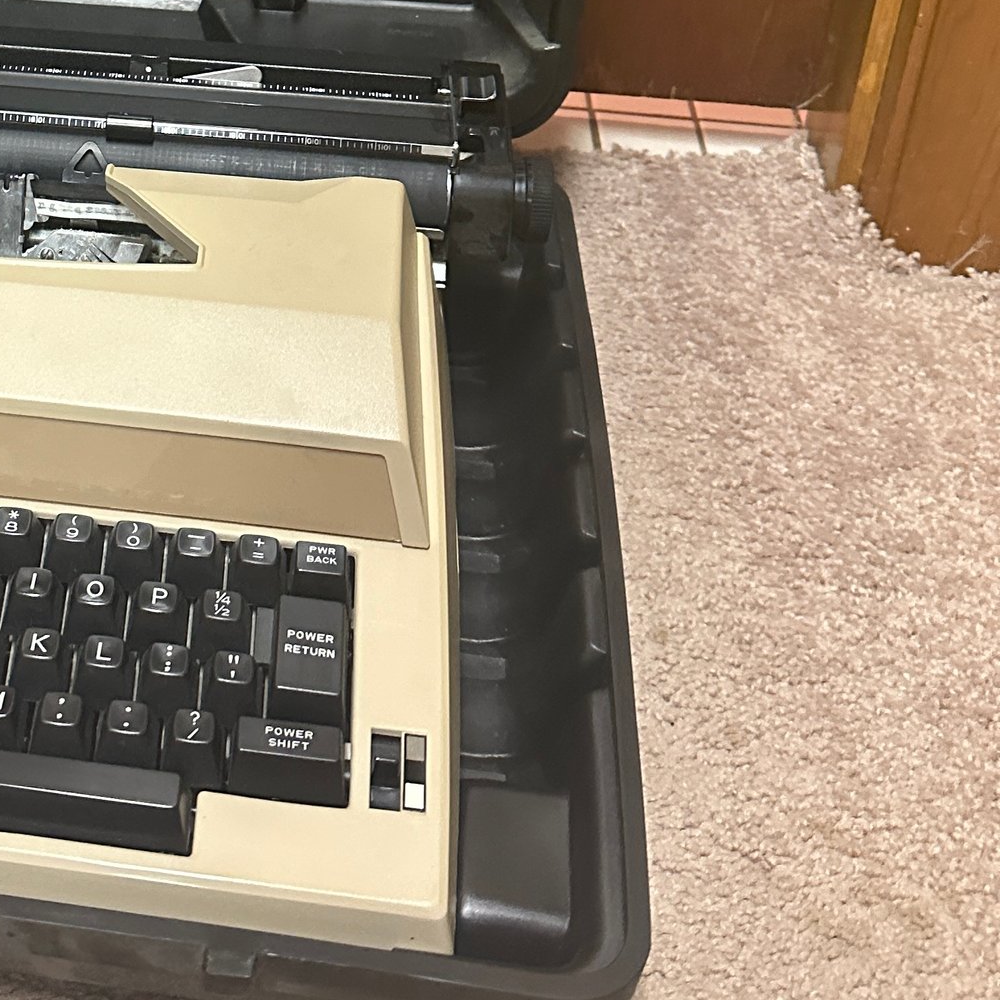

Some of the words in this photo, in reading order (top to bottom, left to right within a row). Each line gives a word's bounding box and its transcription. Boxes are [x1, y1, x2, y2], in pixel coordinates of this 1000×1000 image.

[2, 521, 20, 534] 8
[64, 528, 78, 540] 9
[307, 546, 335, 557] PWR
[306, 555, 336, 565] BACK
[30, 573, 37, 590] I
[84, 581, 104, 598] O
[152, 588, 168, 606] P
[30, 633, 50, 652] K
[285, 630, 334, 645] POWER
[96, 642, 111, 661] L
[284, 644, 335, 658] RETURN
[265, 726, 313, 741] POWER
[269, 736, 309, 750] SHIFT
